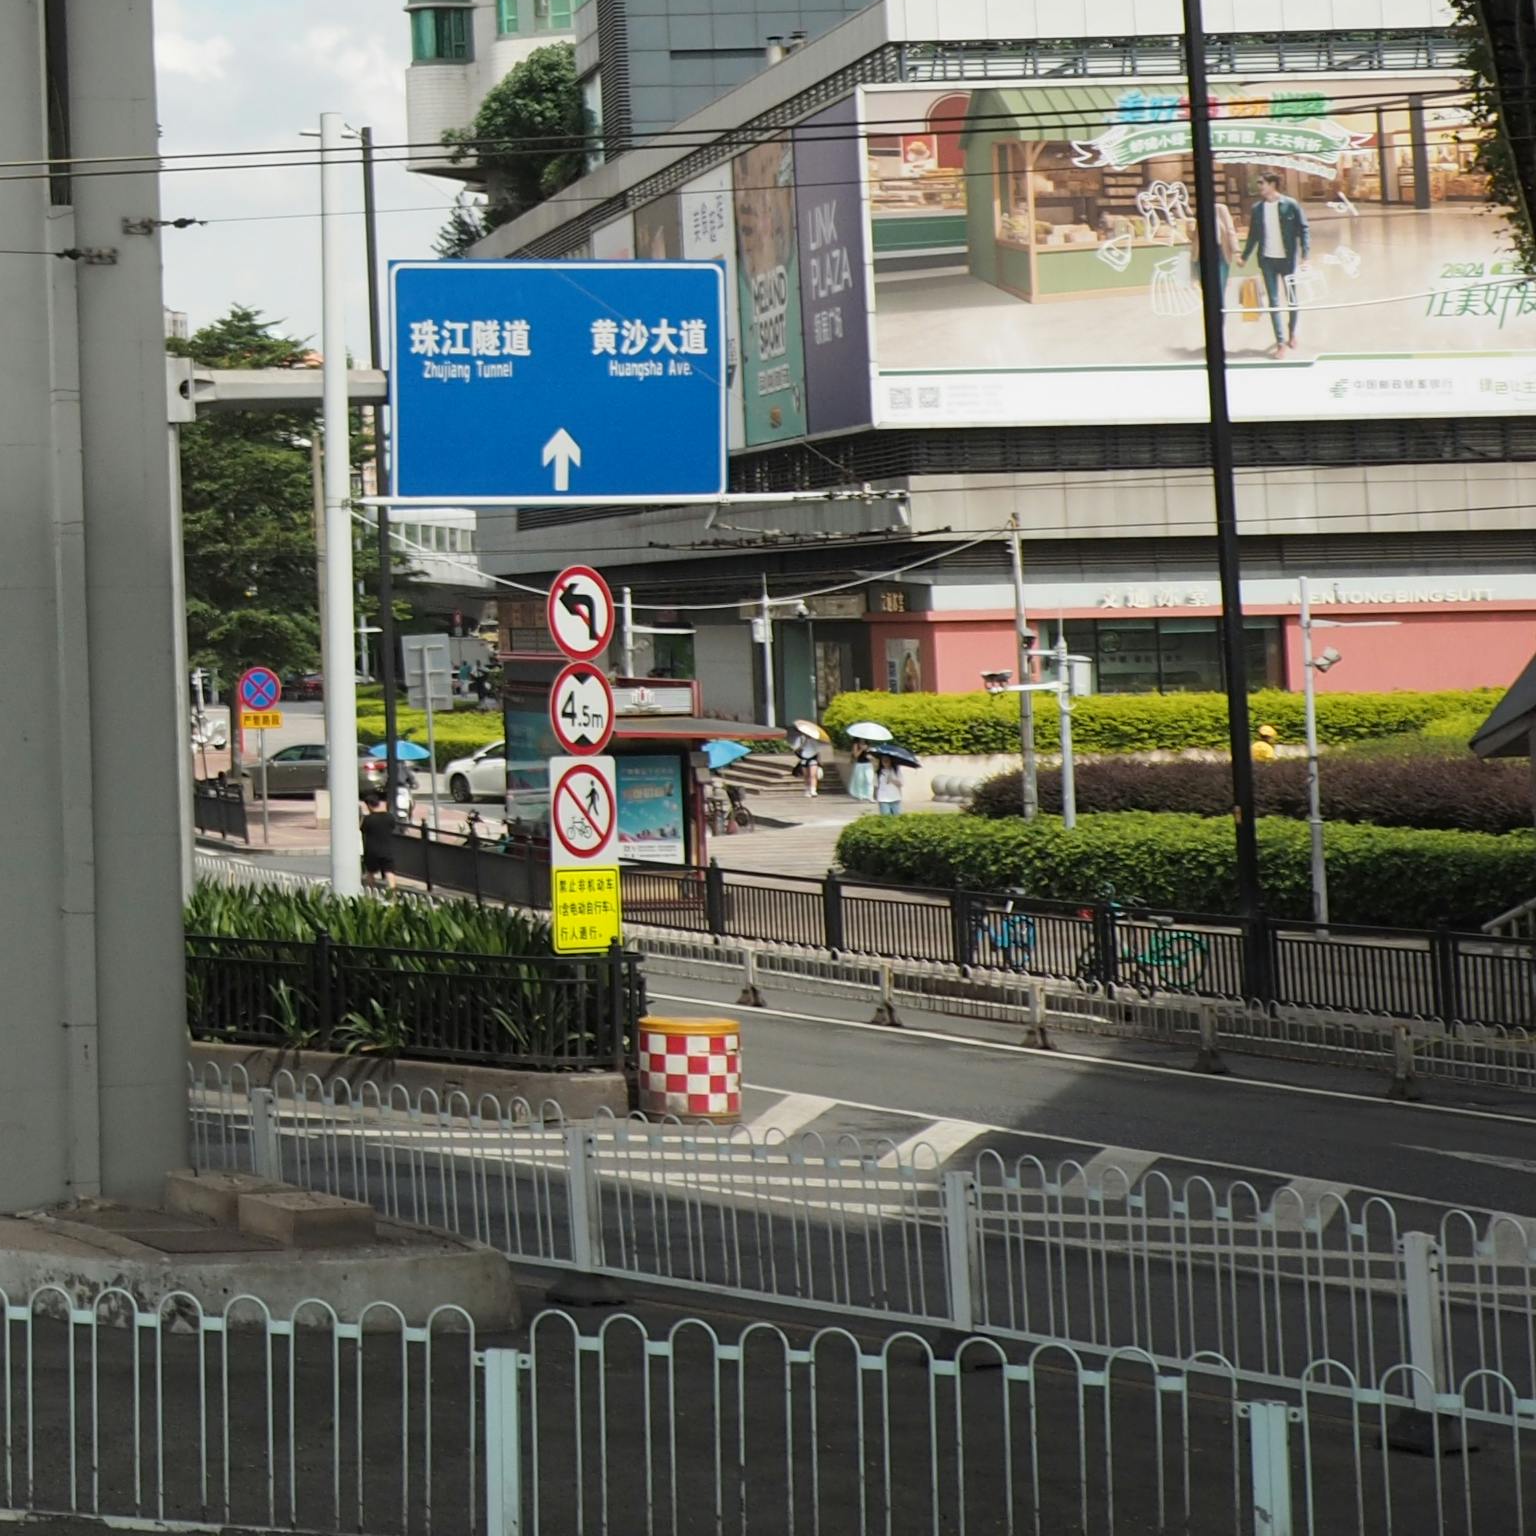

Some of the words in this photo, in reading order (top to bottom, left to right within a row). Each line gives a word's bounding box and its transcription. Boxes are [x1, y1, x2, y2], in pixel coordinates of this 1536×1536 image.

[808, 199, 838, 252] LINK
[811, 247, 853, 302] PLAZA
[409, 318, 532, 358] 珠江隧道
[590, 318, 708, 357] 黄沙大道
[423, 360, 471, 383] Zhujiang
[477, 360, 514, 379] Tunnel
[609, 360, 664, 382] Huangsha
[668, 360, 694, 377] Ave.
[561, 690, 605, 730] 4.5m
[559, 877, 616, 894] 禁止非机动车
